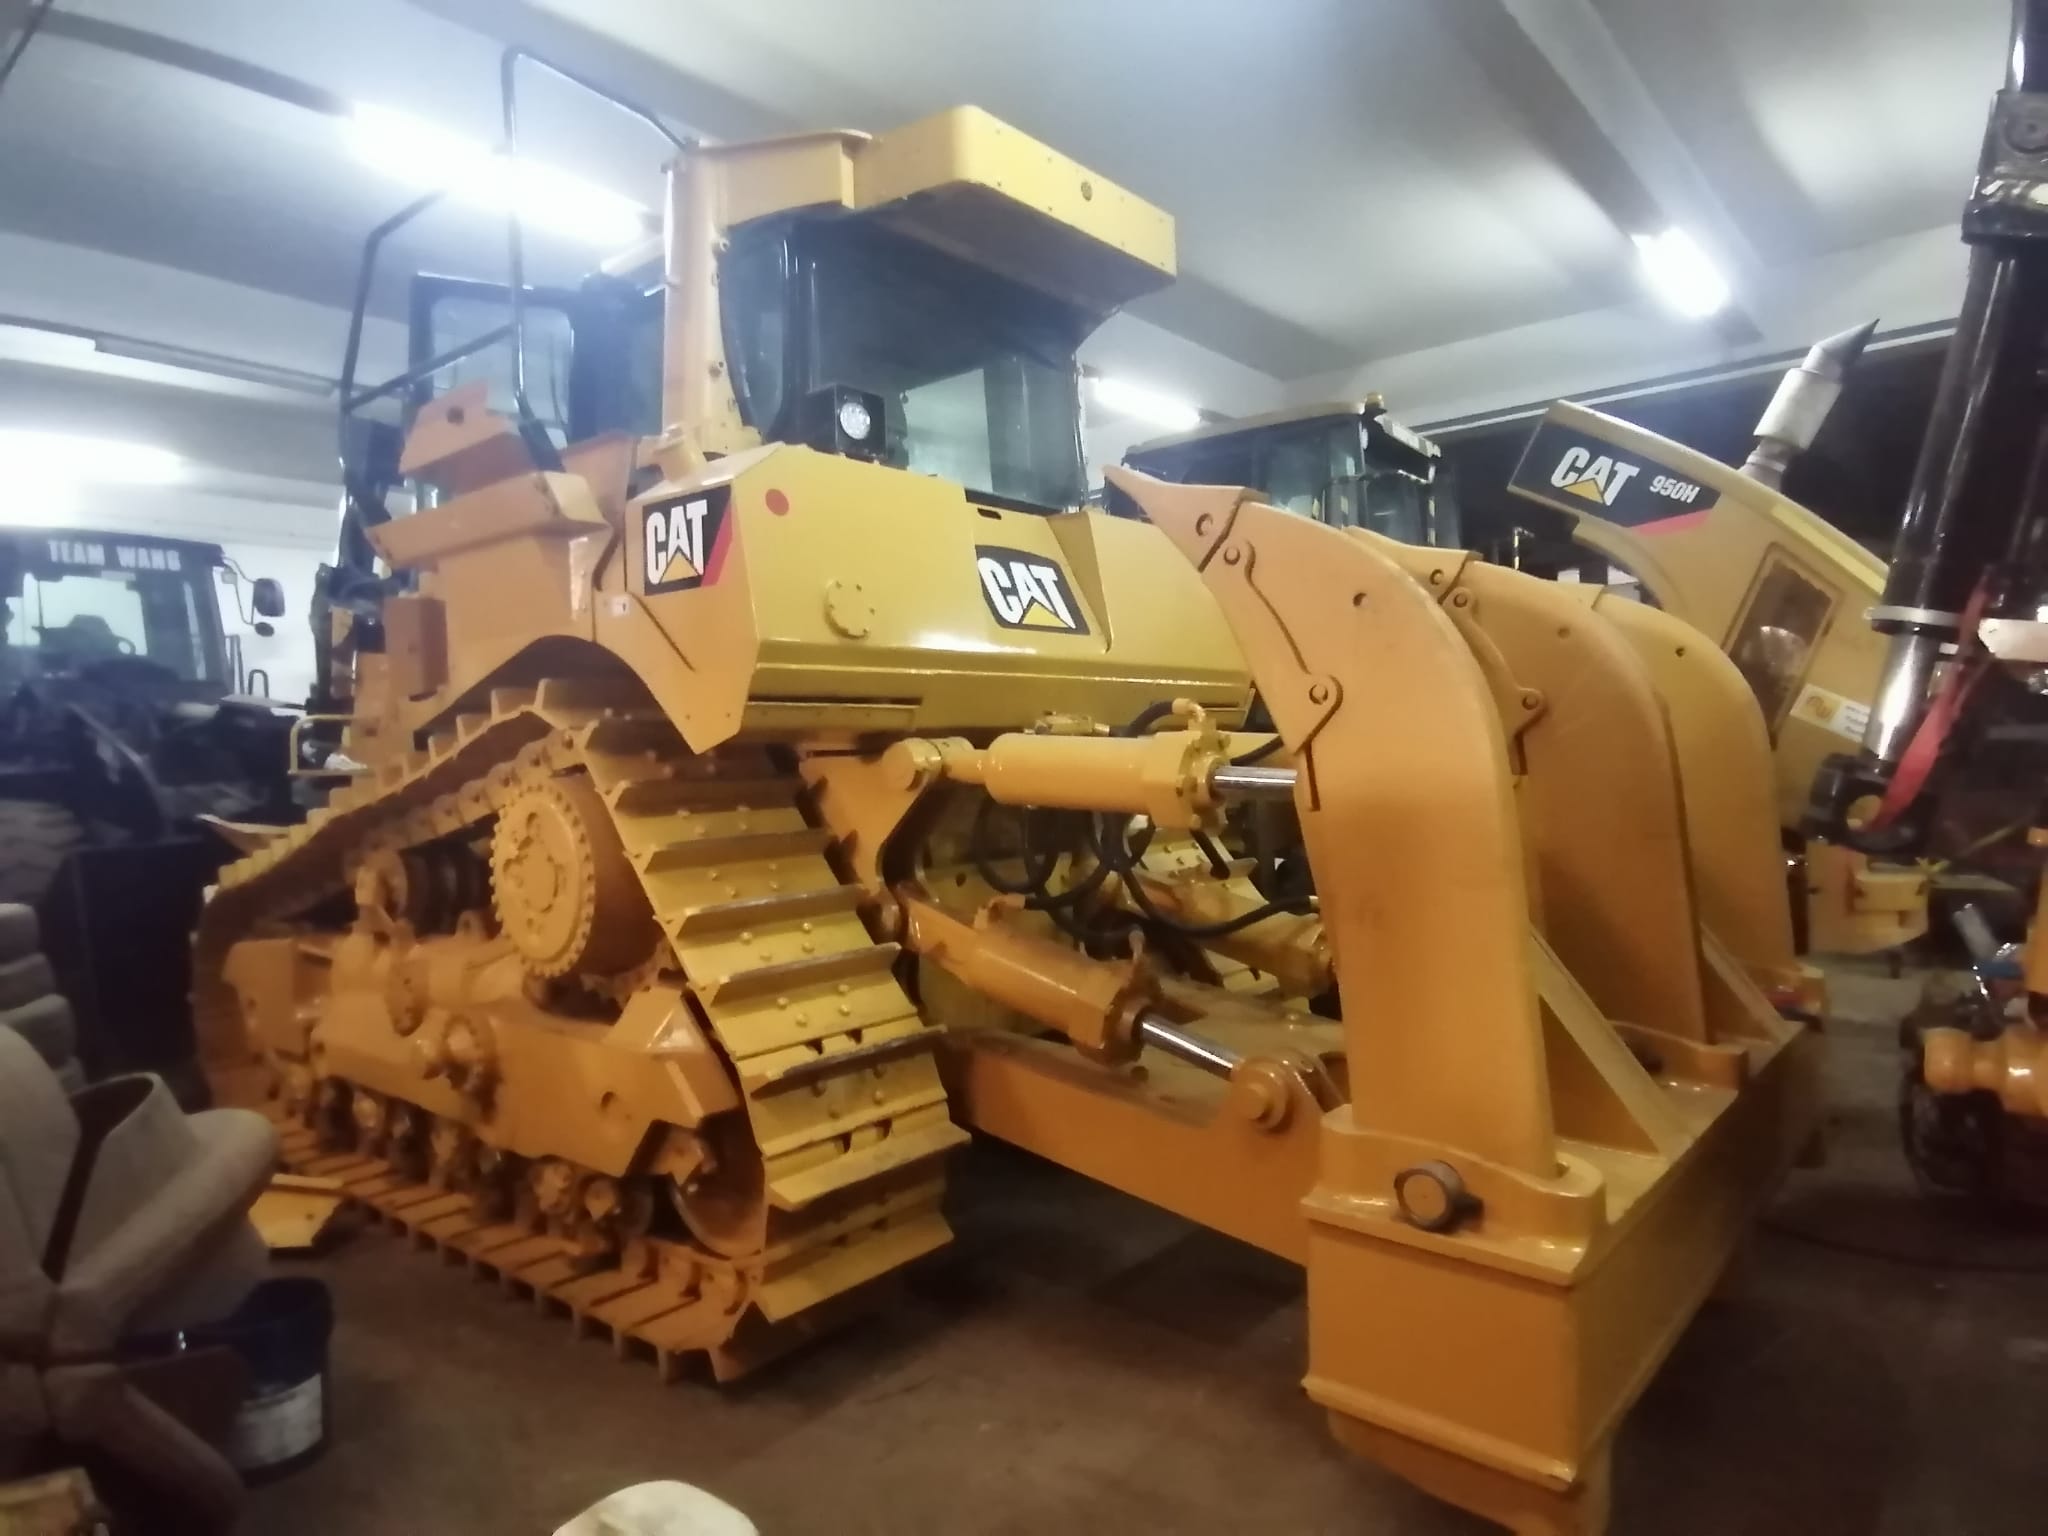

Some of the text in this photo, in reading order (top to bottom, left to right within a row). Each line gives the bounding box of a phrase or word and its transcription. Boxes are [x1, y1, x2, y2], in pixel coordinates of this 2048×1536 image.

[1551, 446, 1700, 506] CAT 950H
[48, 540, 105, 566] TEAM
[646, 499, 708, 585] CAT
[977, 557, 1077, 630] CAT
